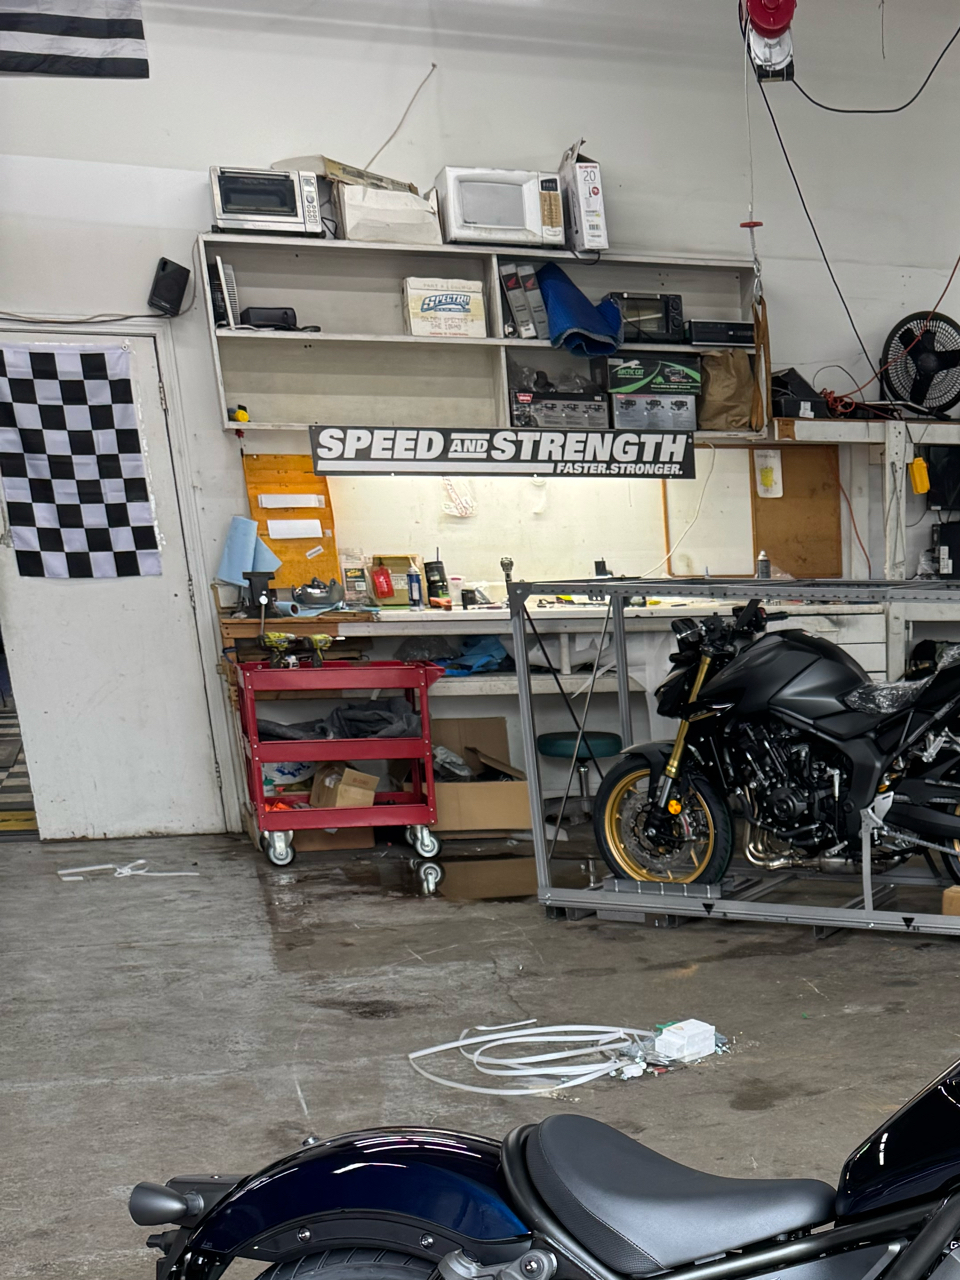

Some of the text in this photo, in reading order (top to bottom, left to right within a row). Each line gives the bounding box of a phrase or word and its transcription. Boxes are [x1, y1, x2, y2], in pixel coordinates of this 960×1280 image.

[423, 295, 471, 309] SPECTRO
[317, 428, 687, 463] SPEED AND STRENGTH
